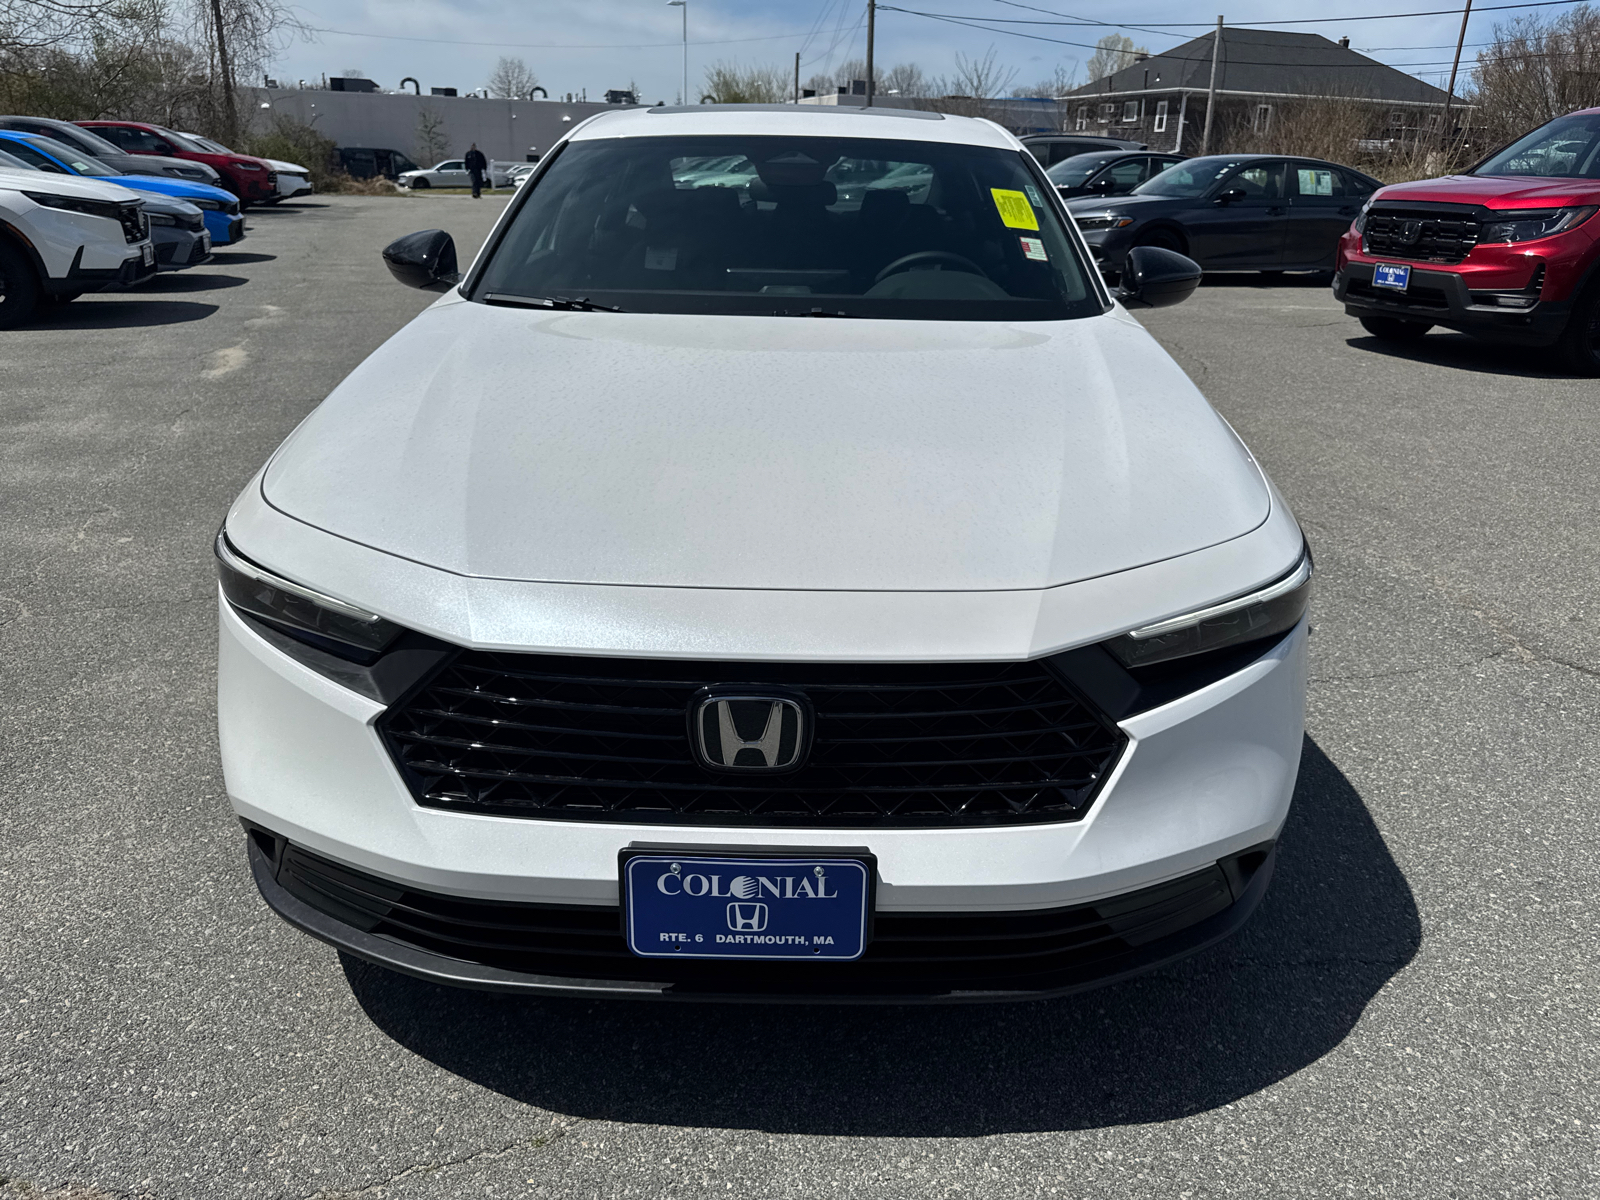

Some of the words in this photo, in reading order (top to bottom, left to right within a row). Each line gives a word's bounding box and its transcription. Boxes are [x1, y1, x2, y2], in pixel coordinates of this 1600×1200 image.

[657, 872, 838, 900] COLONIAL
[659, 932, 691, 944] RTE.
[694, 933, 704, 944] 6
[715, 934, 809, 947] DARTMOUTH,
[813, 935, 835, 946] MA
